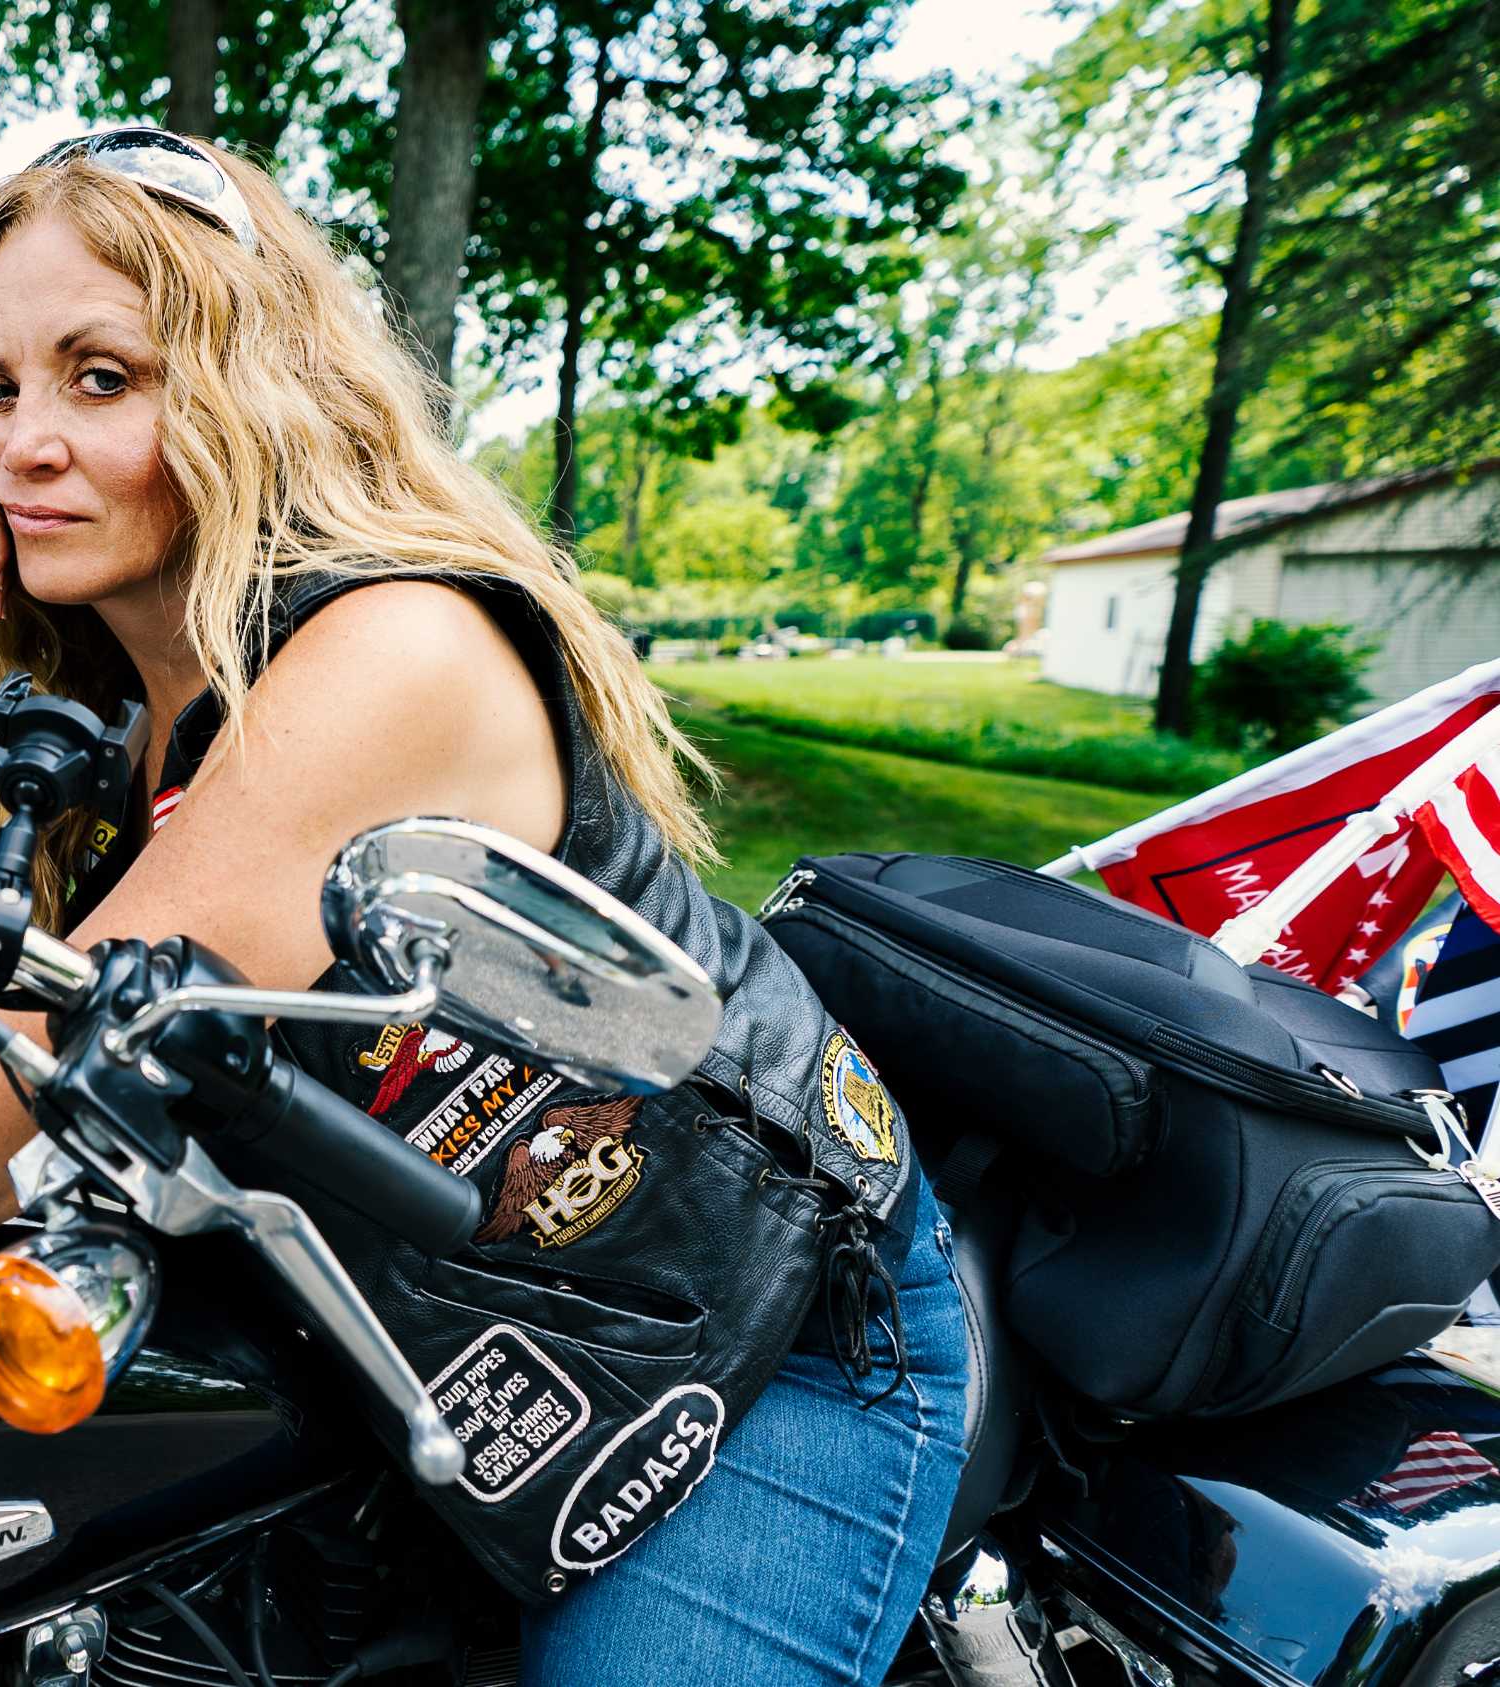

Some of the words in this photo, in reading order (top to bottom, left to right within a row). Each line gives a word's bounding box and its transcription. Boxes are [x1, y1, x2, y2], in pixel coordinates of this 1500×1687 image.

[376, 1025, 404, 1060] STU
[822, 1035, 846, 1068] TOWER
[413, 1094, 470, 1153] WHAT
[468, 1057, 515, 1099] PAR
[430, 1114, 481, 1166] KISS
[482, 1079, 515, 1117] MY
[478, 1118, 503, 1144] YOU
[822, 1068, 837, 1127] DEVILS
[522, 1136, 633, 1236] HOG
[556, 1218, 588, 1243] HARLEY
[586, 1196, 617, 1224] OWNERS
[613, 1169, 636, 1199] GROUP
[437, 1380, 470, 1417] OUD
[464, 1348, 507, 1387] PIPES
[454, 1404, 494, 1443] SAVE
[487, 1372, 530, 1413] LIVES
[466, 1381, 491, 1408] MAY
[472, 1433, 515, 1475] JESUS
[510, 1389, 559, 1438] CHRIST
[483, 1443, 531, 1487] SAVES
[526, 1404, 572, 1449] SOULS
[490, 1407, 515, 1432] BUT
[571, 1410, 704, 1554] BADASS
